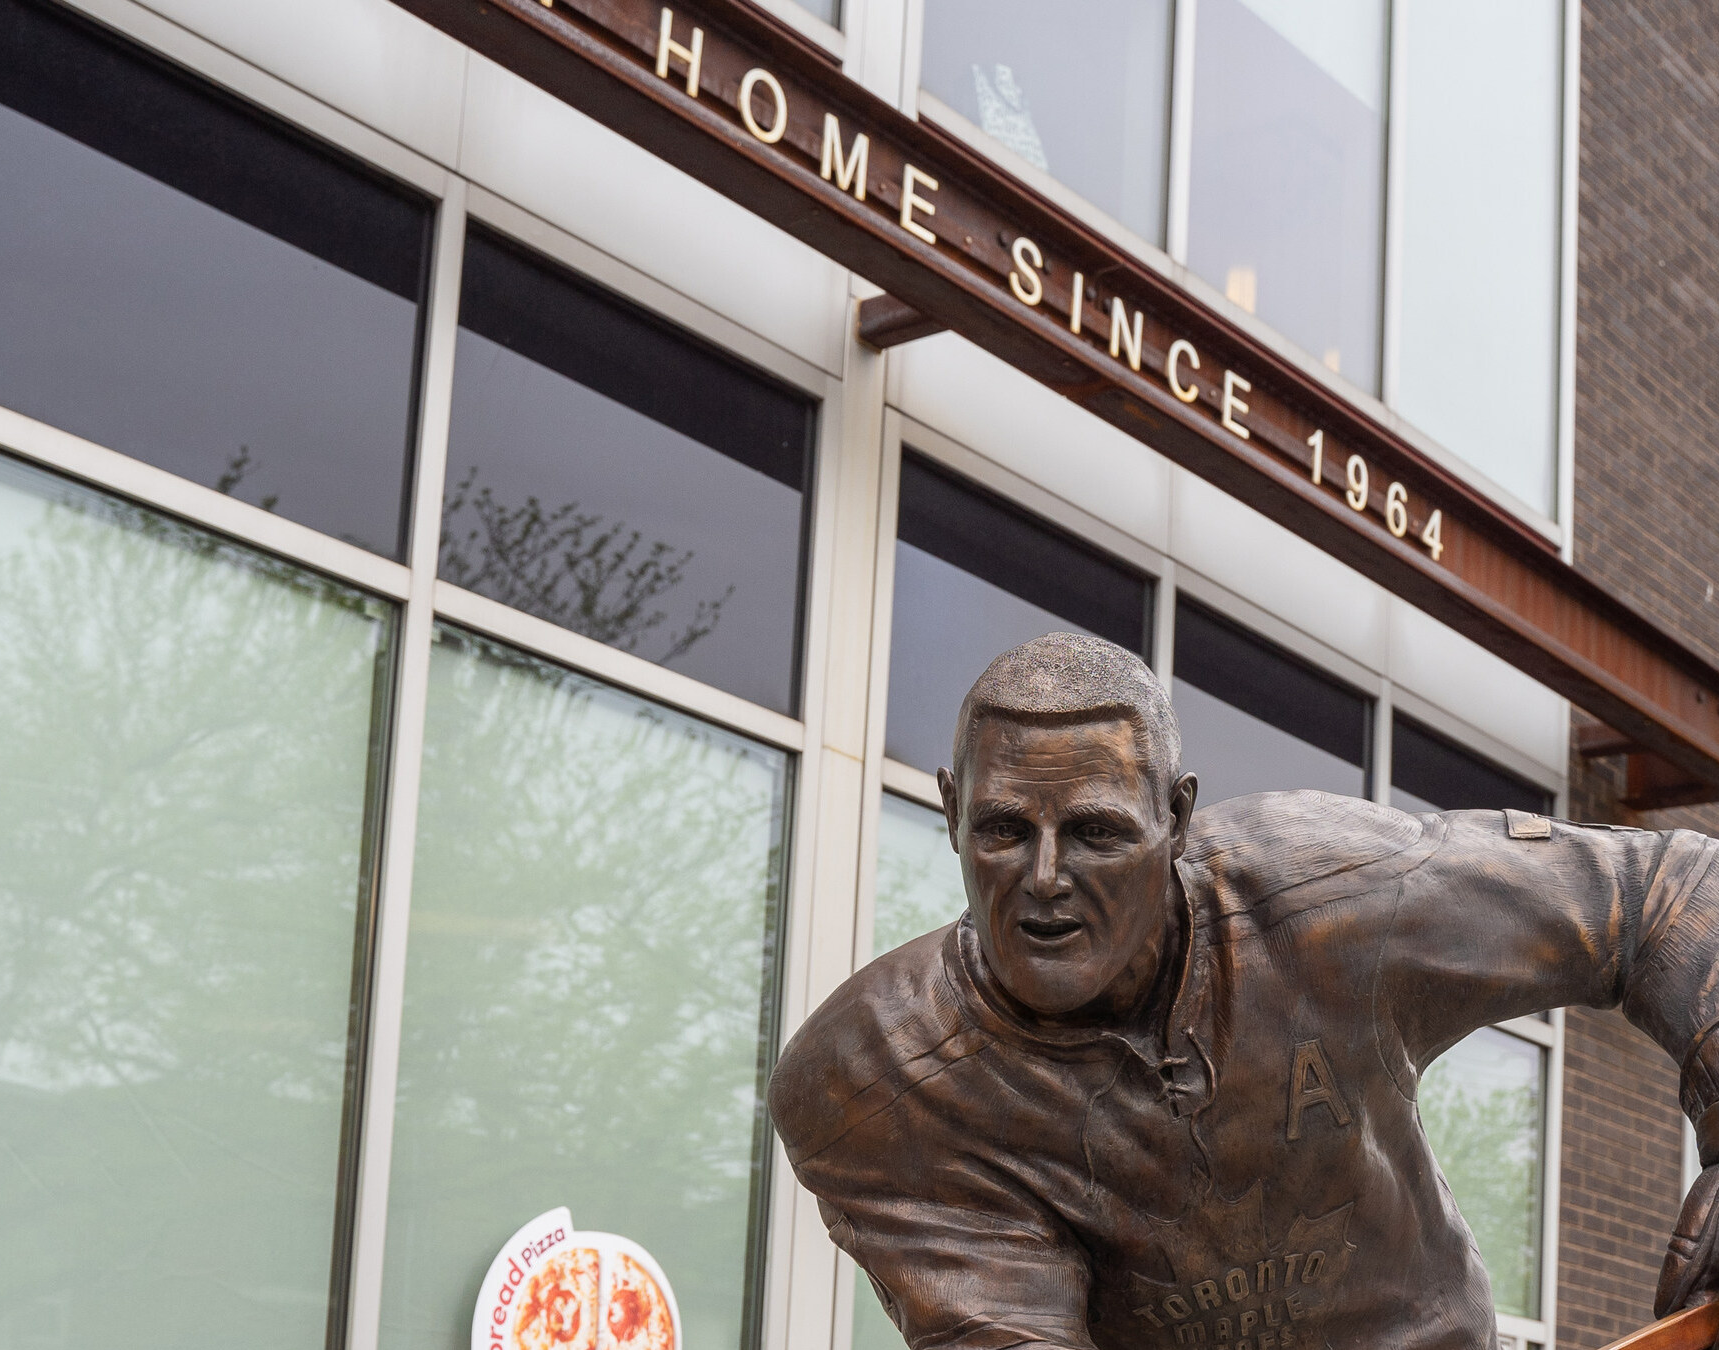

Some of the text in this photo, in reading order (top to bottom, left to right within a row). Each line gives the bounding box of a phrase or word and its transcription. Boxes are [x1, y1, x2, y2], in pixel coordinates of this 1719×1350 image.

[655, 7, 1445, 562] HOME SINCE 1964
[1286, 1038, 1353, 1141] A
[521, 1228, 566, 1268] Pizza
[1132, 1249, 1326, 1328] TORONTO
[1174, 1290, 1307, 1344] MAPLE
